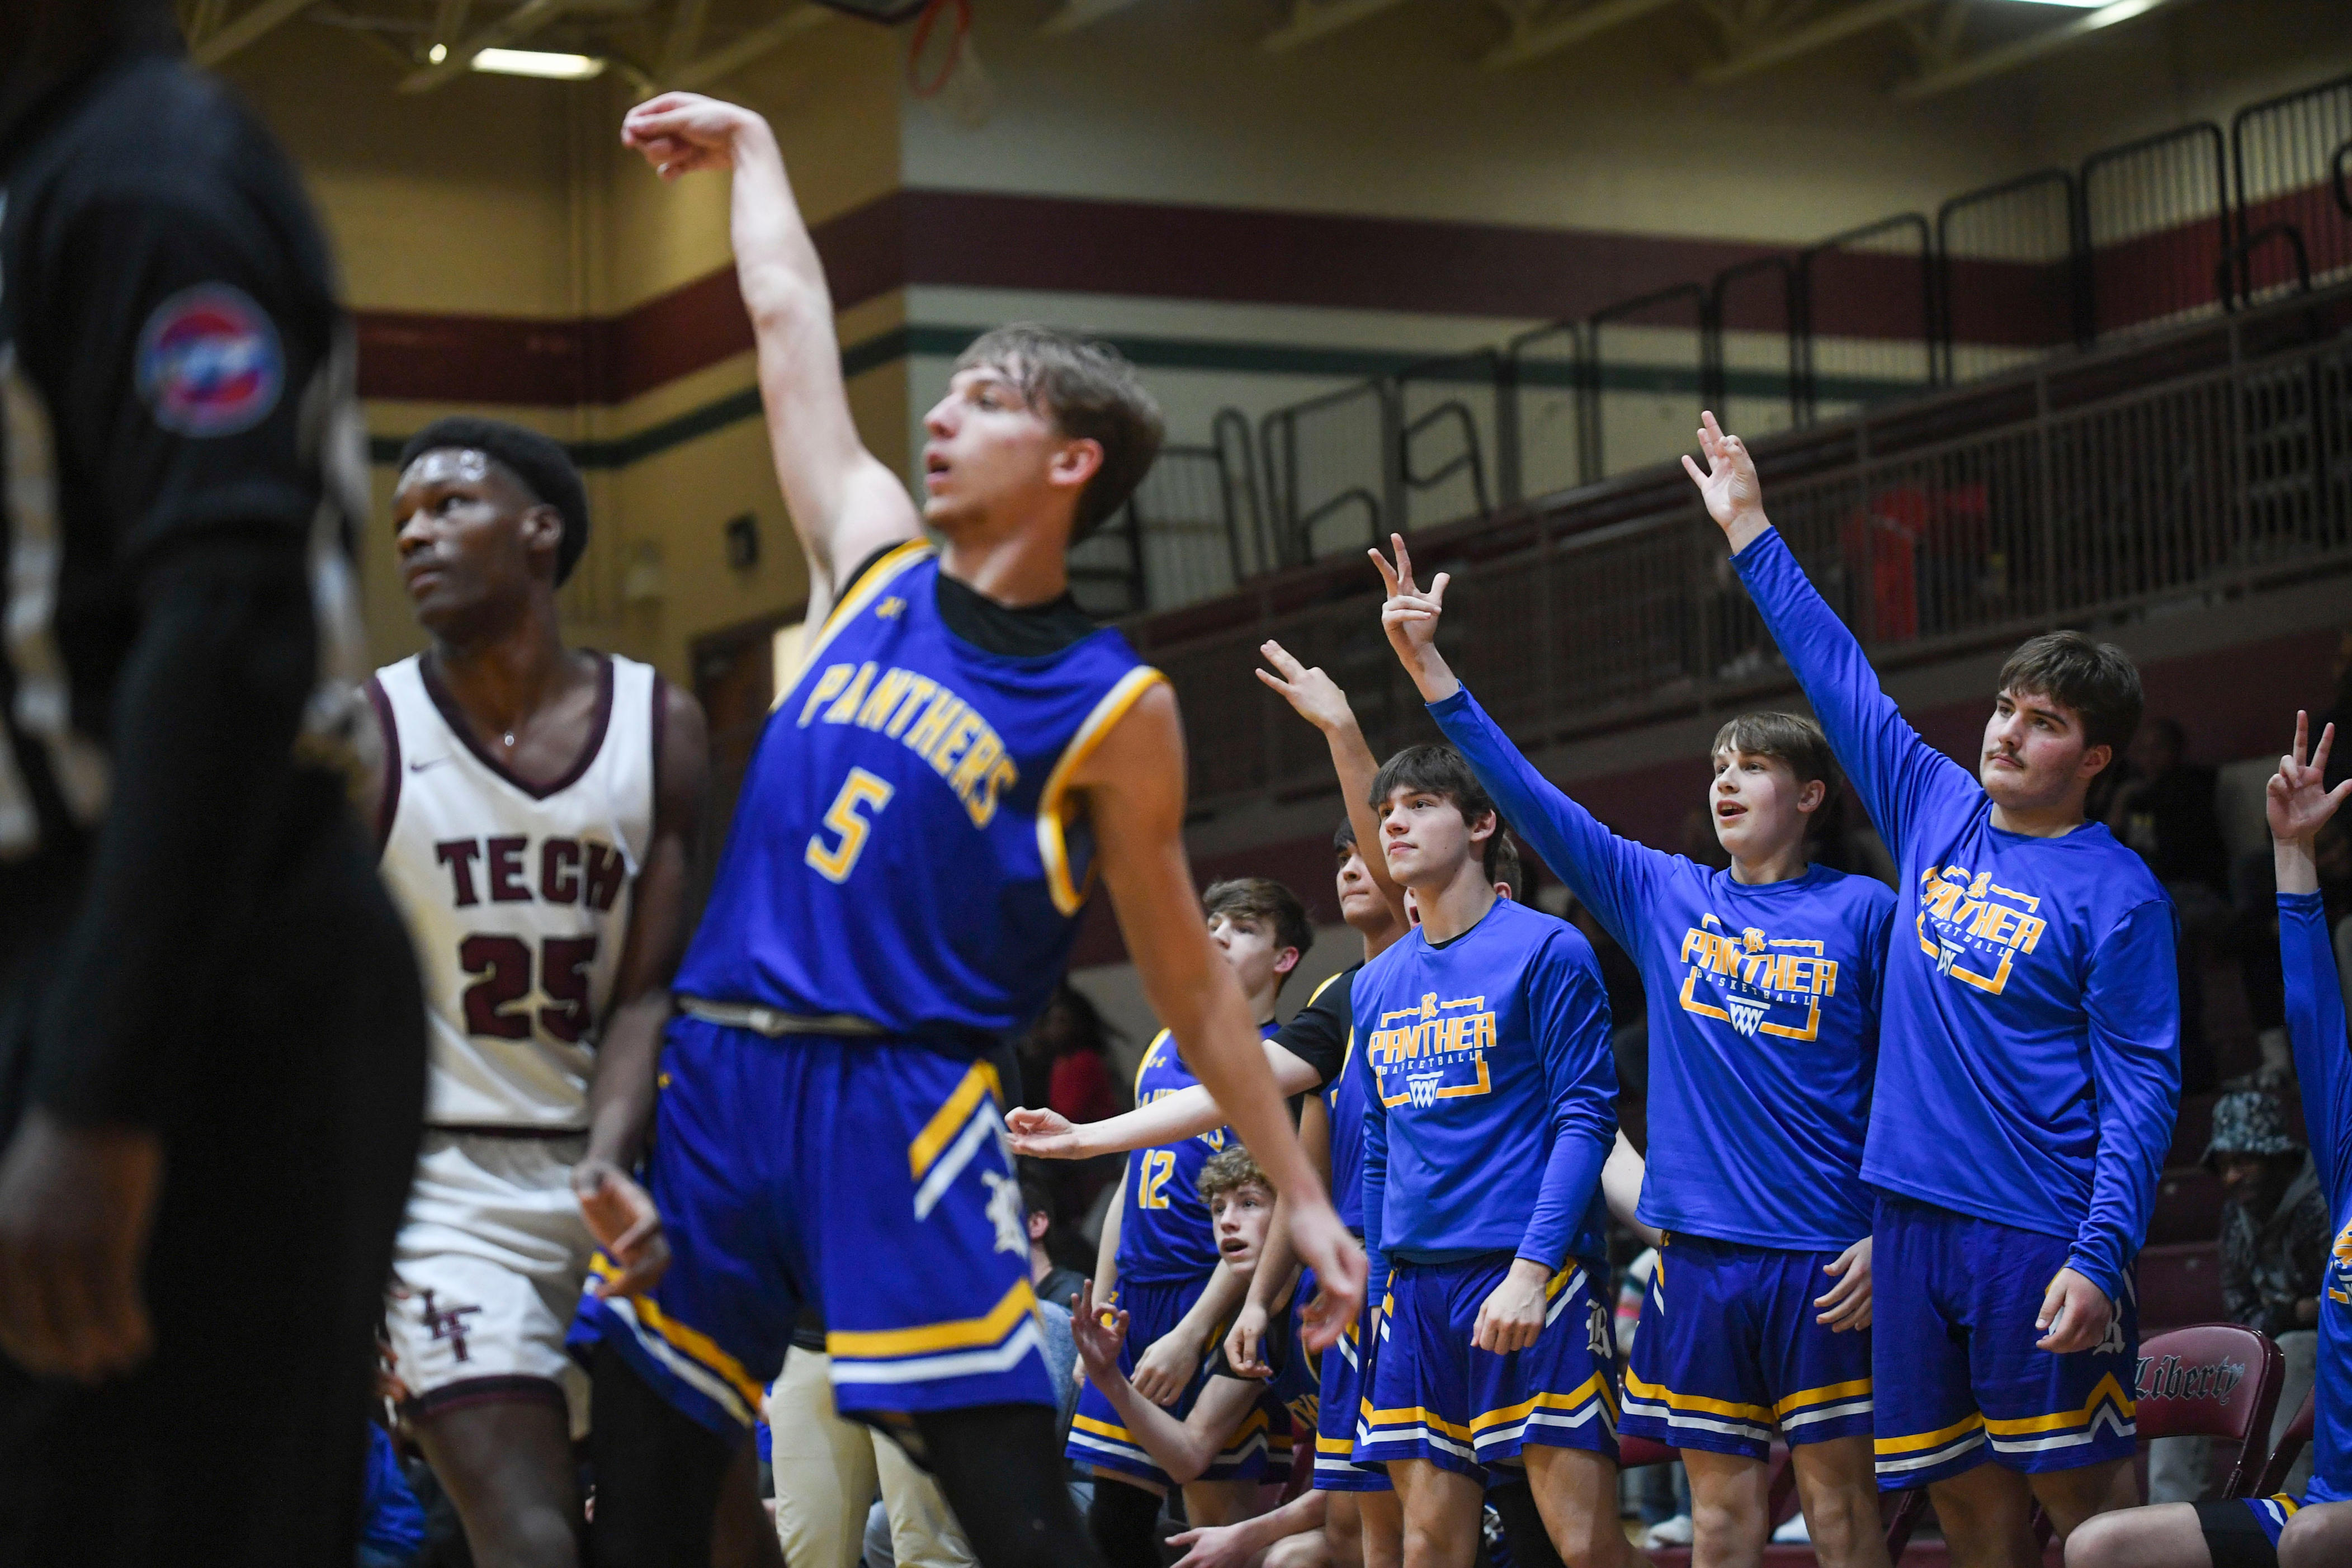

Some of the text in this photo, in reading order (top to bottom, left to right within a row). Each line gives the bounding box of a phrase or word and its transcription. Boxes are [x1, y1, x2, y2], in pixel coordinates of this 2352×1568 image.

[797, 662, 1019, 830] PANTHERS
[804, 767, 896, 885] 5
[434, 836, 625, 911] TECH
[1680, 927, 1839, 998] PANTHER
[1742, 927, 1767, 954] R
[457, 933, 599, 1042] 25
[1697, 970, 1811, 1006] BASKETBALL
[1368, 1011, 1497, 1068] PANTHER
[1139, 1149, 1177, 1209] 12
[2134, 1354, 2246, 1406] Liberty
